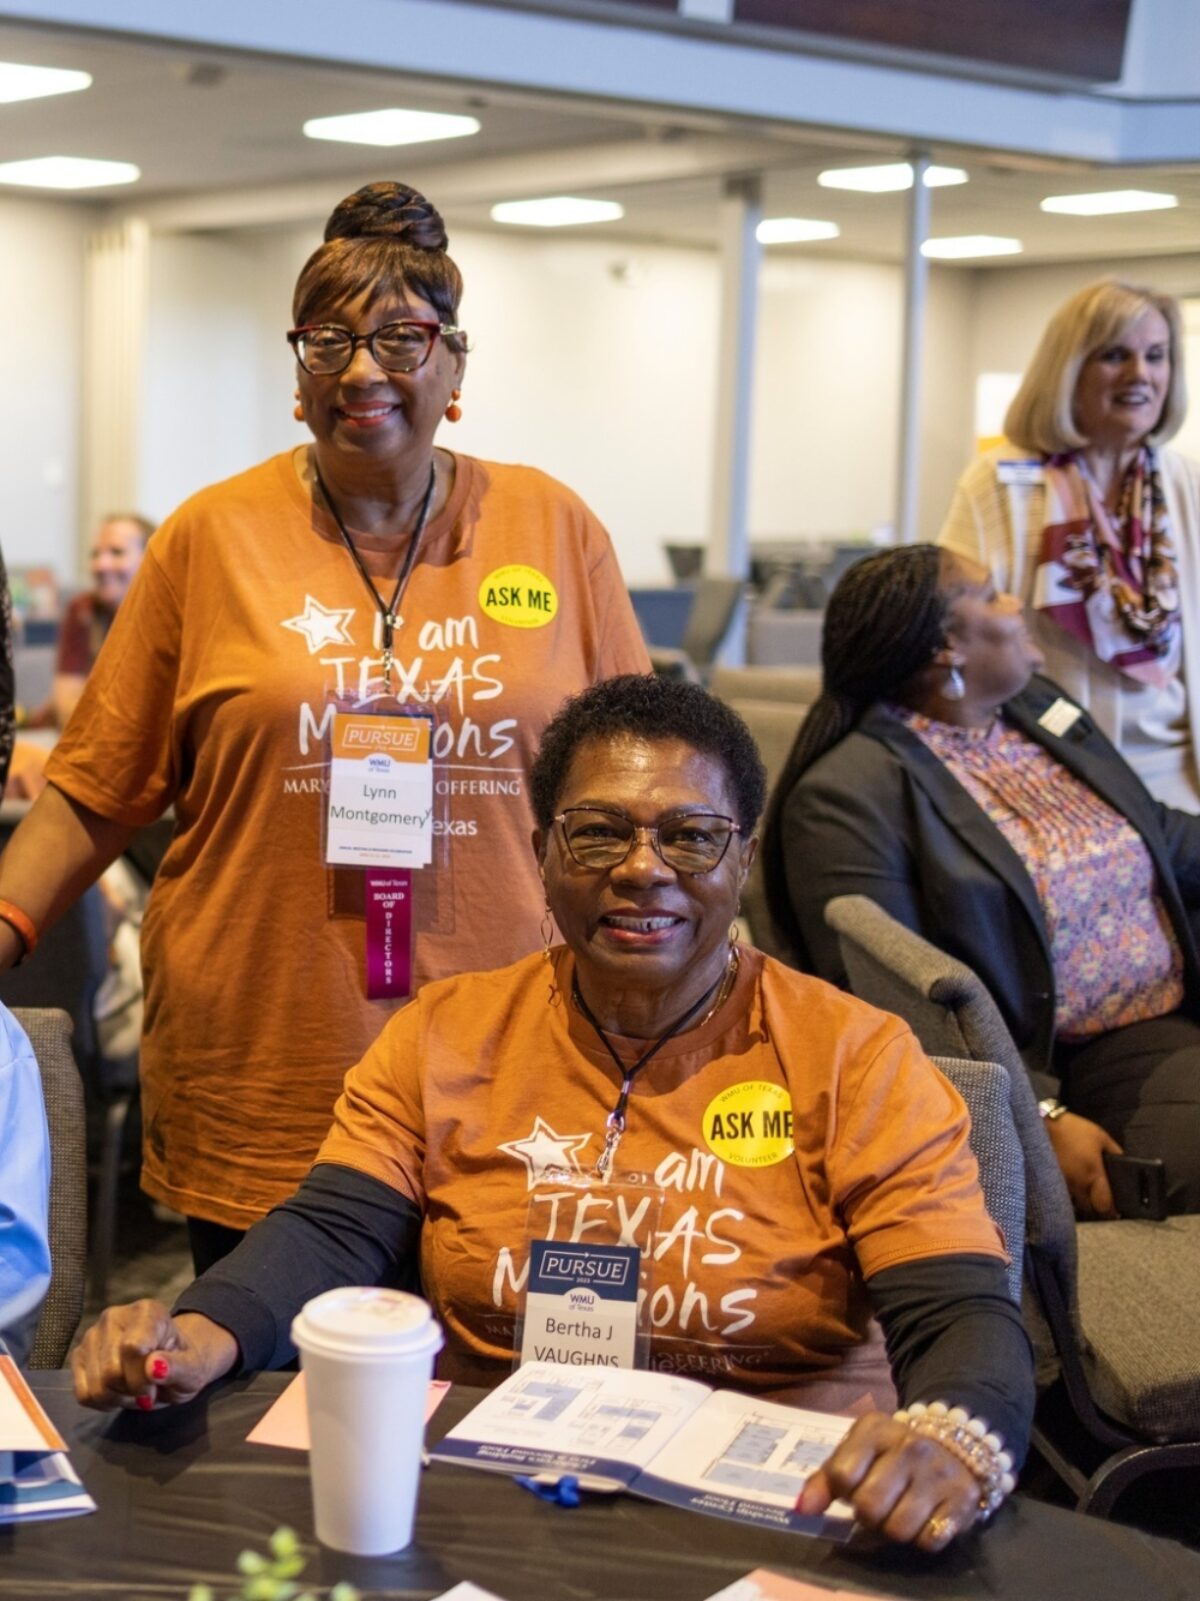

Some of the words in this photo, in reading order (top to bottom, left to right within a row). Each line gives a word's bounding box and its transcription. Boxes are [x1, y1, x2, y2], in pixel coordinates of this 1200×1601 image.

[485, 586, 522, 607] ASK
[527, 588, 552, 612] ME
[418, 615, 480, 651] am
[319, 653, 504, 716] TEXAS
[299, 702, 518, 759] Mons
[348, 728, 415, 747] PURSUE
[362, 783, 398, 800] Lynn
[435, 779, 521, 796] OFFERING
[329, 805, 427, 829] Montgomery
[432, 818, 478, 836] exas
[373, 892, 405, 901] BOARD
[720, 1088, 740, 1103] WMU
[742, 1084, 754, 1092] OF
[710, 1111, 755, 1141] ASK
[762, 1110, 794, 1139] ME
[728, 1151, 779, 1165] VOLUNTEER
[654, 1148, 725, 1197] am
[533, 1192, 745, 1280] TEXAS
[546, 1257, 623, 1279] PURSUE
[570, 1293, 595, 1305] WMU
[545, 1317, 601, 1339] Bertha
[605, 1324, 614, 1341] J
[533, 1345, 620, 1369] VAUGHNS
